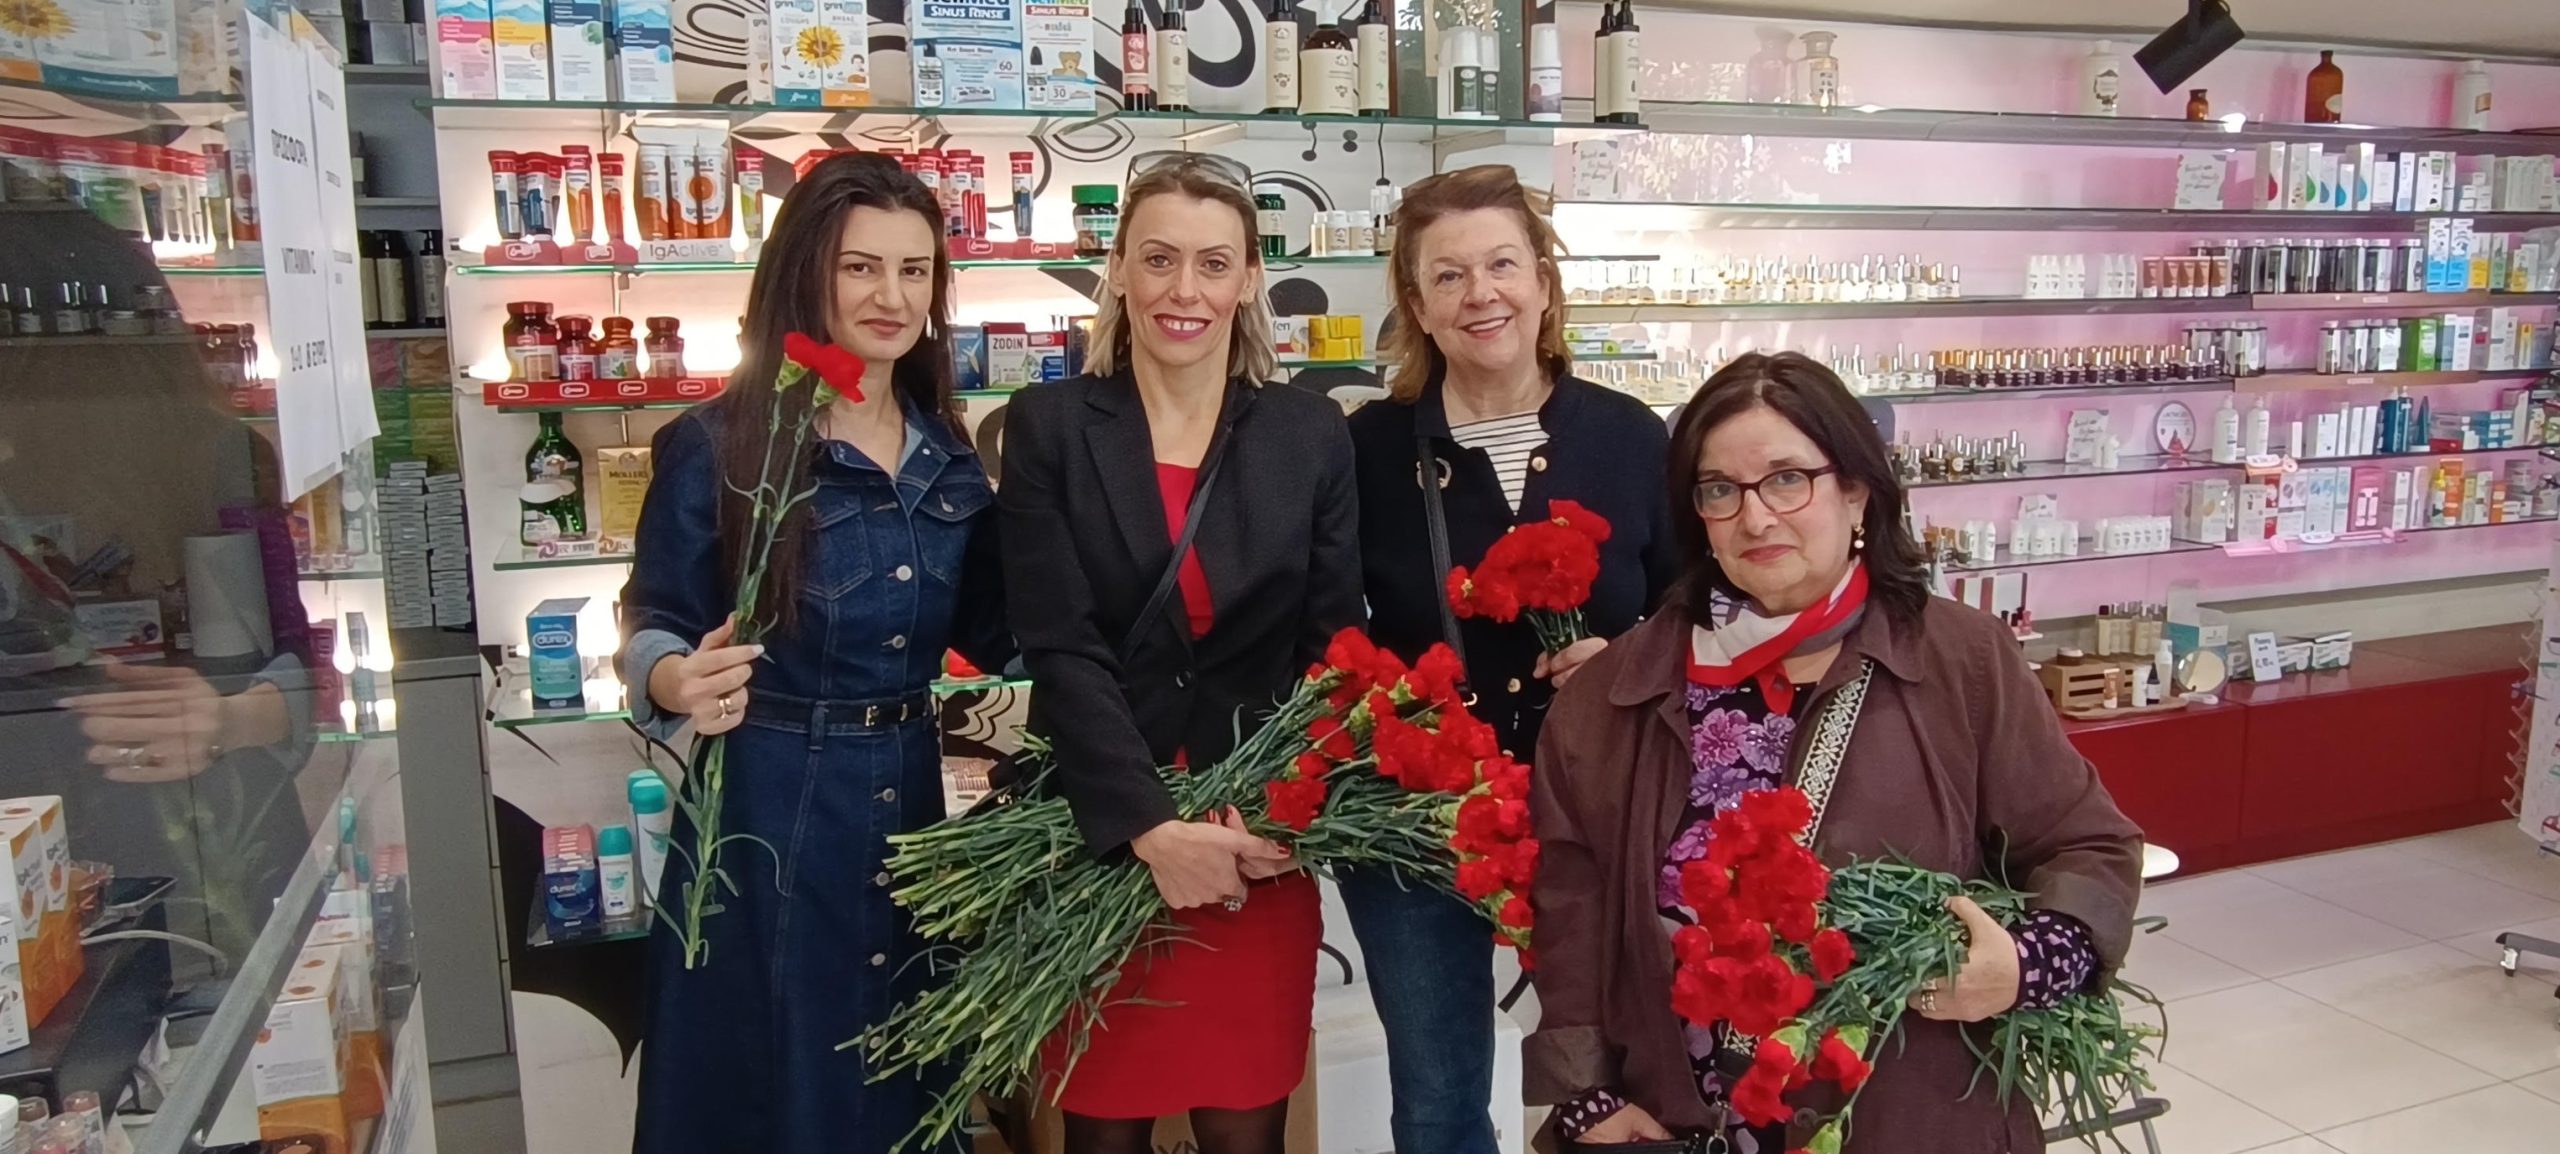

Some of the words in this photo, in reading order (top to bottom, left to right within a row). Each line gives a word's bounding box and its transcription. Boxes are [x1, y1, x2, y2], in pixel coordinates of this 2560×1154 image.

[930, 5, 966, 18] SINUS
[968, 7, 1007, 20] RINSE
[999, 60, 1013, 71] 60
[1053, 88, 1067, 98] 30
[649, 244, 719, 261] IgActive
[992, 337, 1024, 350] ZODIN
